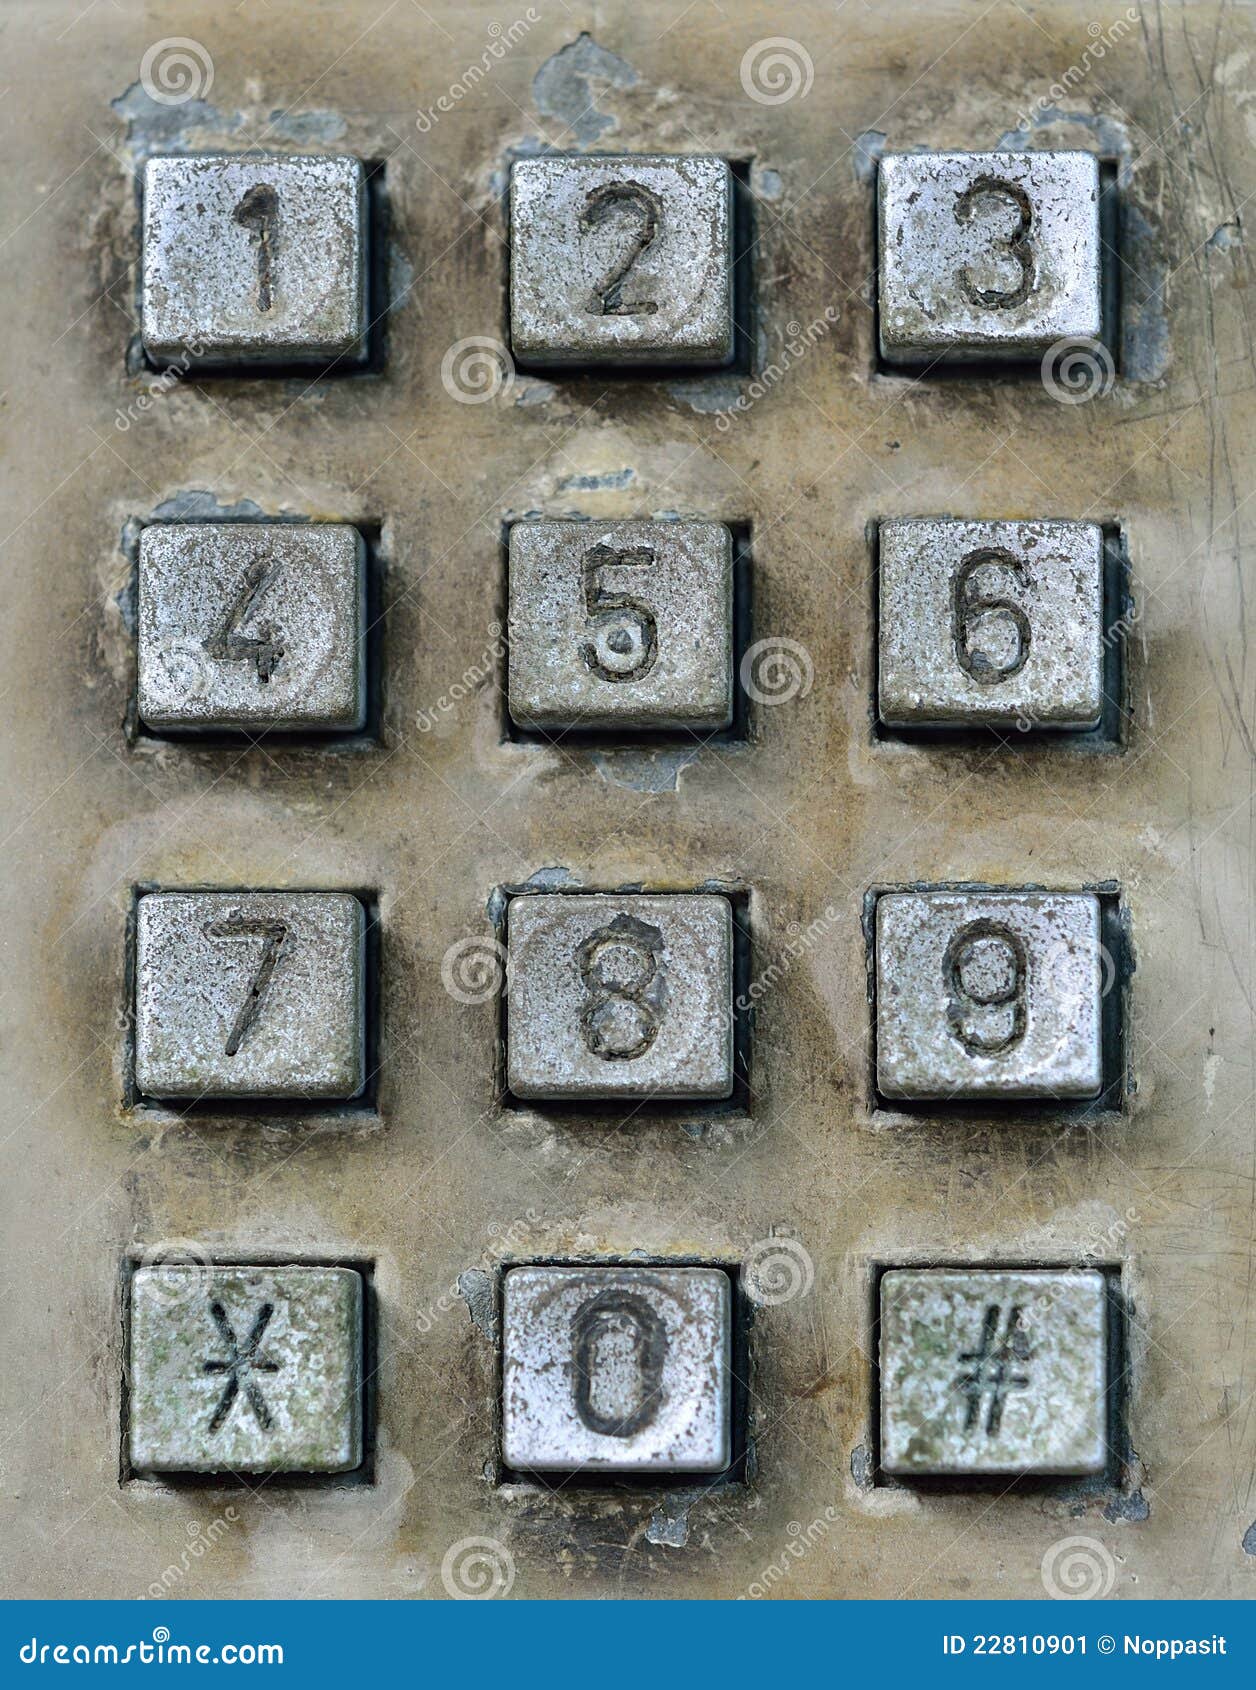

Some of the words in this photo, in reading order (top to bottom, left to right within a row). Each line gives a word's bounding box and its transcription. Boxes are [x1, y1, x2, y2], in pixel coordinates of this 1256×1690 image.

[232, 182, 280, 312] 1
[578, 178, 664, 317] 2
[952, 173, 1037, 311] 3
[201, 557, 286, 684] 4
[577, 542, 659, 684] 5
[949, 545, 1032, 686] 6
[202, 916, 288, 1057] 7
[574, 912, 666, 1062] 8
[942, 916, 1028, 1058] 9
[570, 1287, 669, 1438] 0
[952, 1303, 1030, 1436] #
